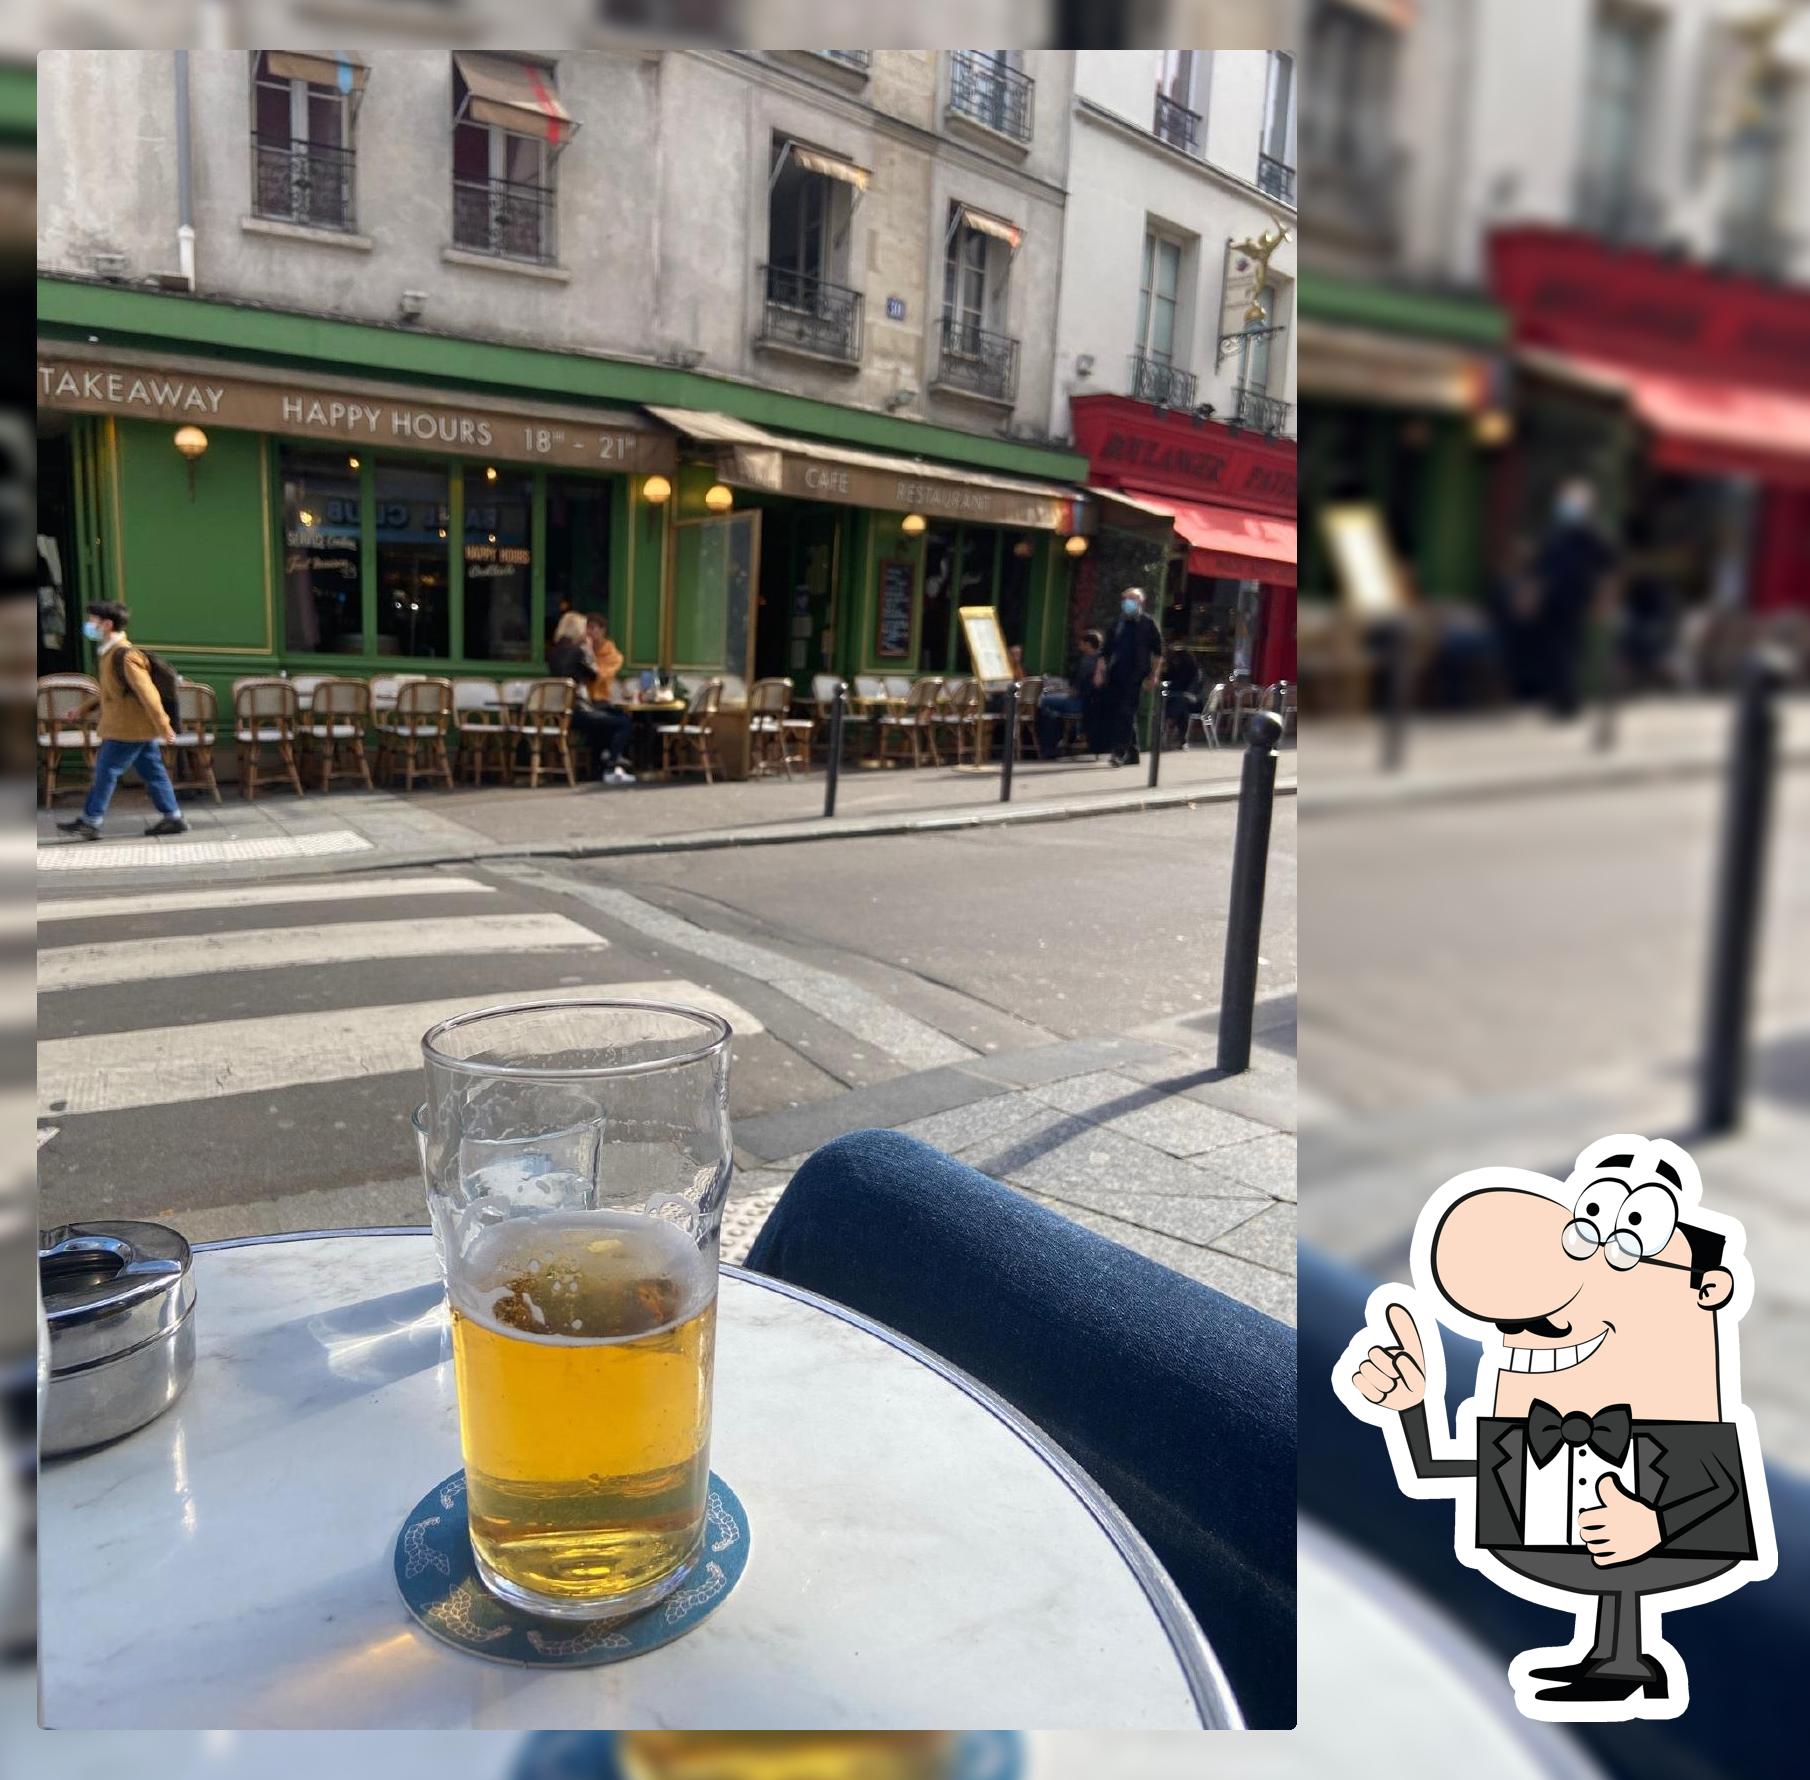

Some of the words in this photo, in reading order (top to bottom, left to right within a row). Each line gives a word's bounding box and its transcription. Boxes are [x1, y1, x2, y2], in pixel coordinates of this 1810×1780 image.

[38, 366, 223, 413] TAKEAWAY
[282, 396, 382, 432] HAPPY
[391, 409, 493, 447] HOURS
